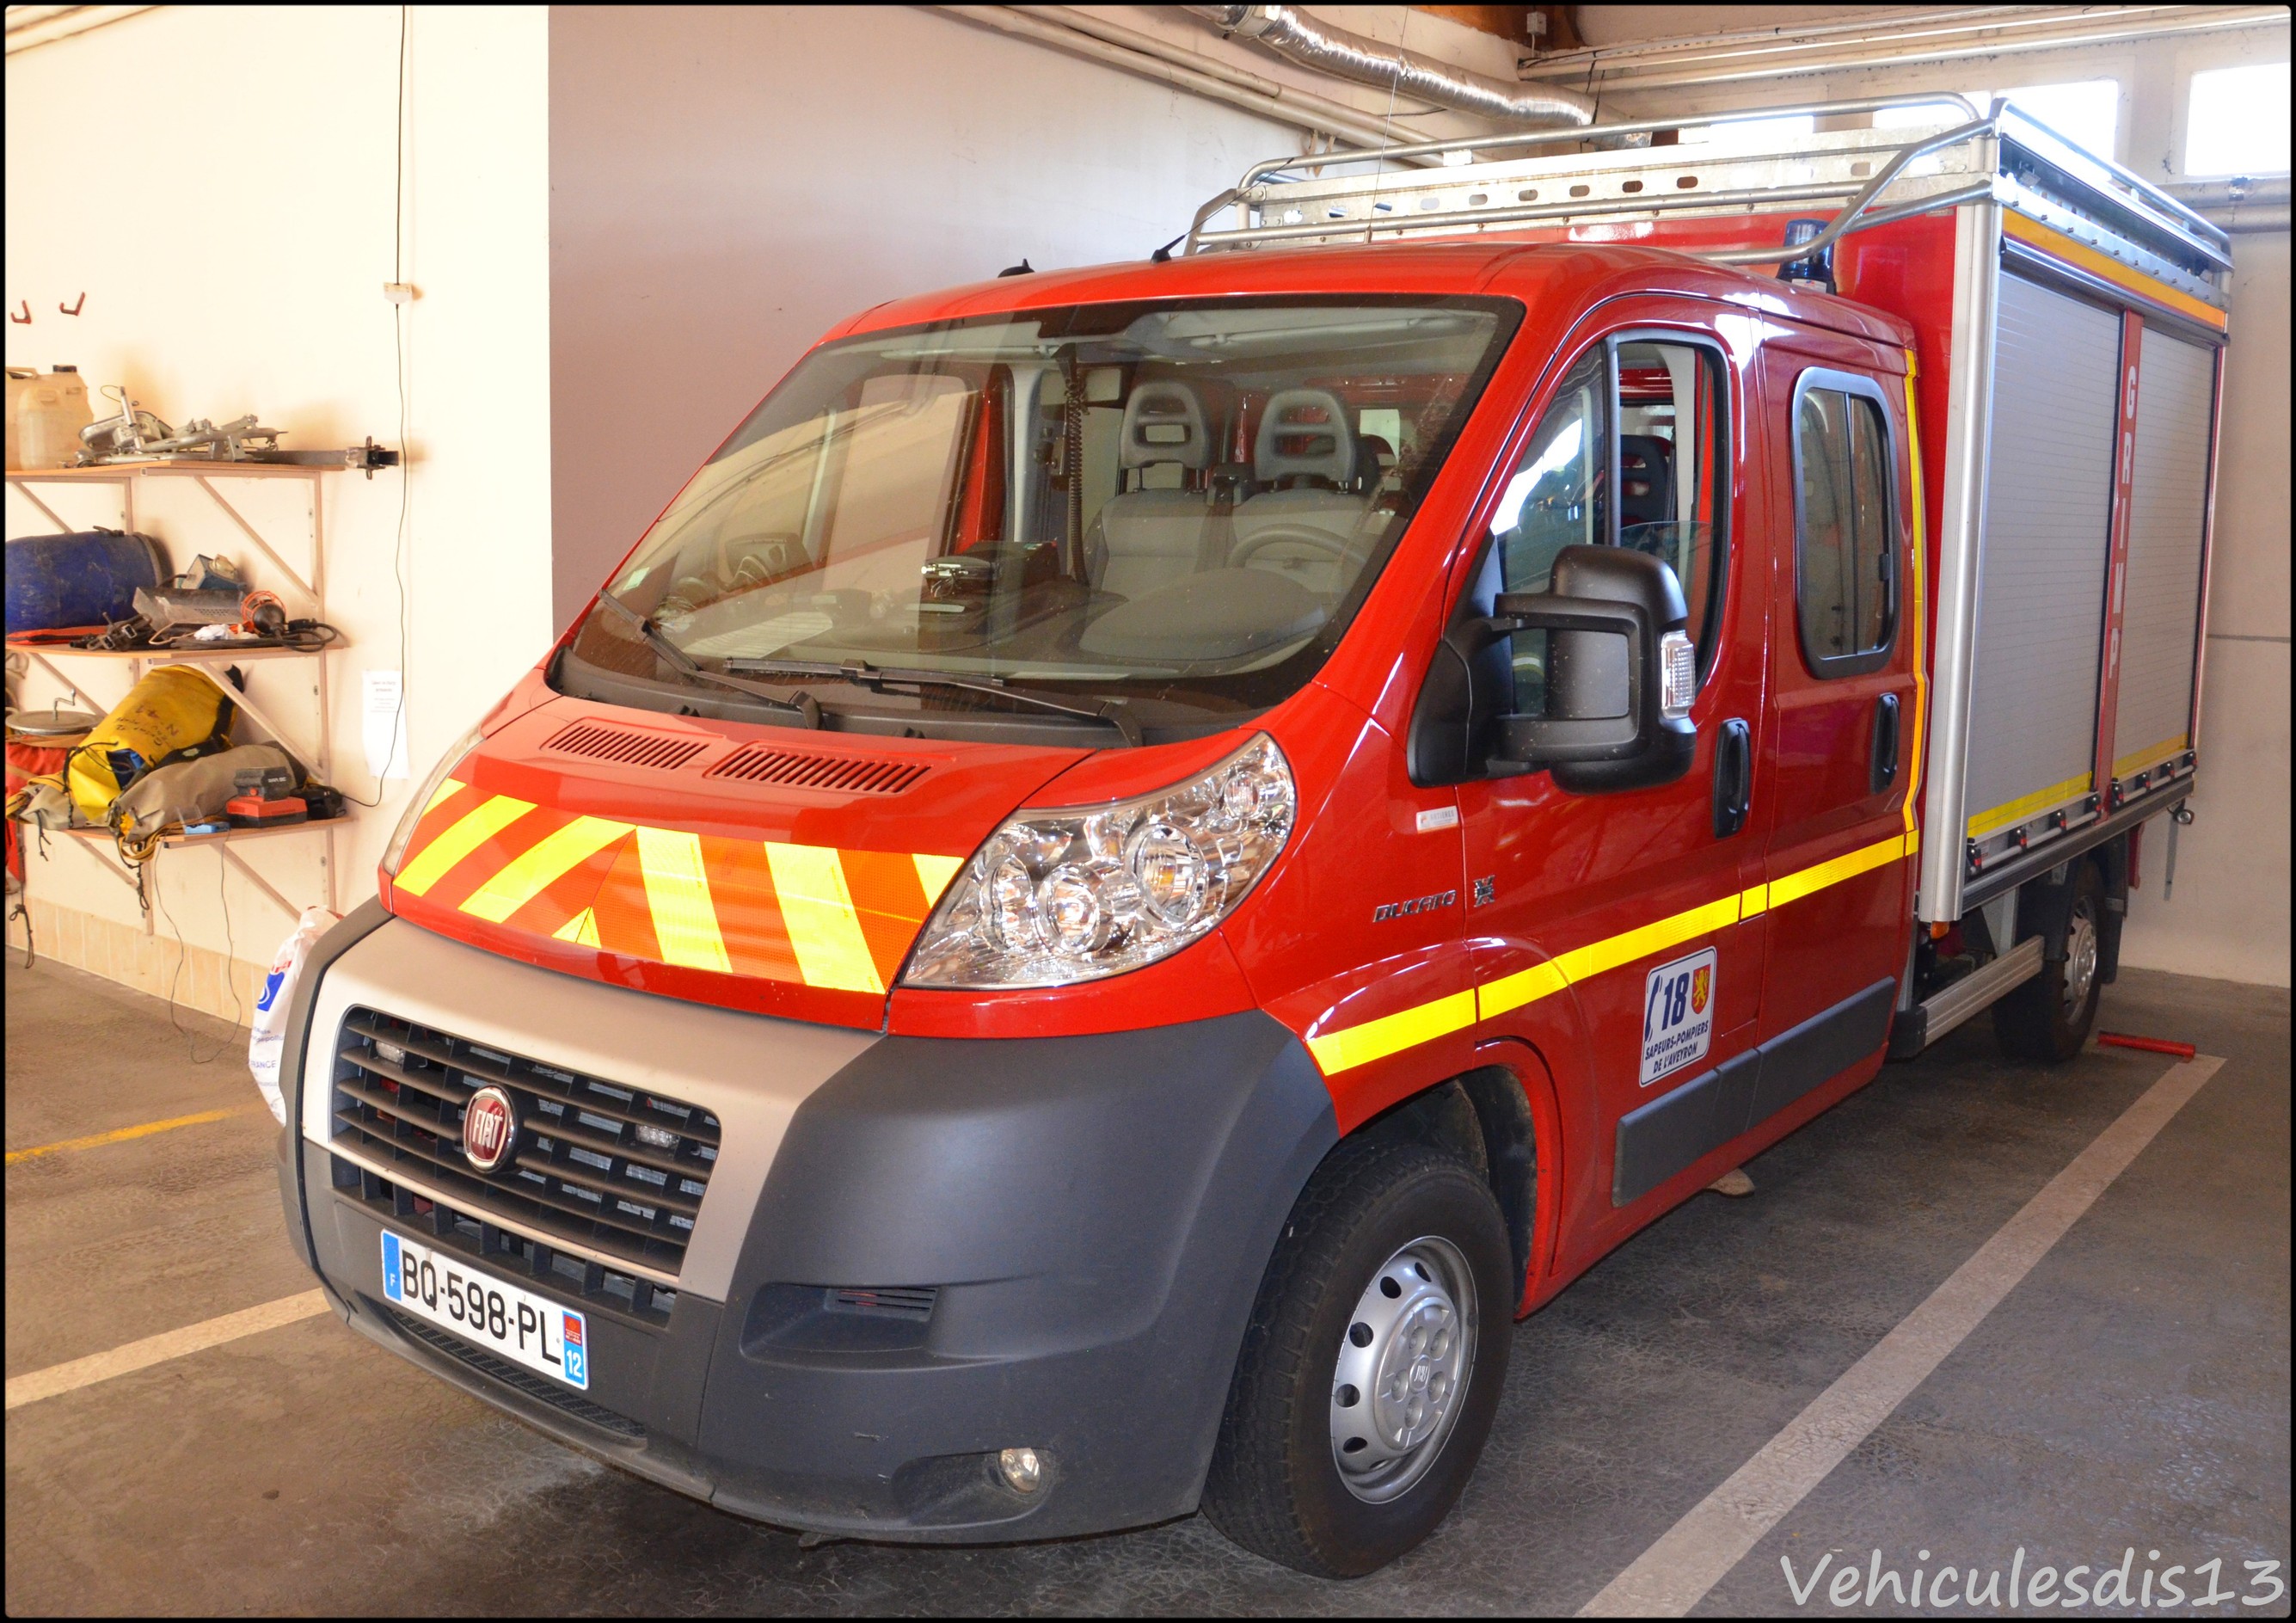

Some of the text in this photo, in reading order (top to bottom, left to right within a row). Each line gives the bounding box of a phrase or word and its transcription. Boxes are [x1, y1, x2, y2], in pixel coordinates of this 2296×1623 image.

[2108, 365, 2137, 679] GRIMP
[1372, 889, 1457, 923] DUCATO
[1661, 971, 1690, 1031] 18
[1644, 1019, 1710, 1060] SAPEURS-POMPIERS
[1653, 1042, 1698, 1074] DE L'AVEYRON
[471, 1109, 504, 1150] FIAT
[389, 1273, 396, 1288] F
[402, 1250, 562, 1366] BQ-598-PL
[567, 1349, 583, 1379] 12
